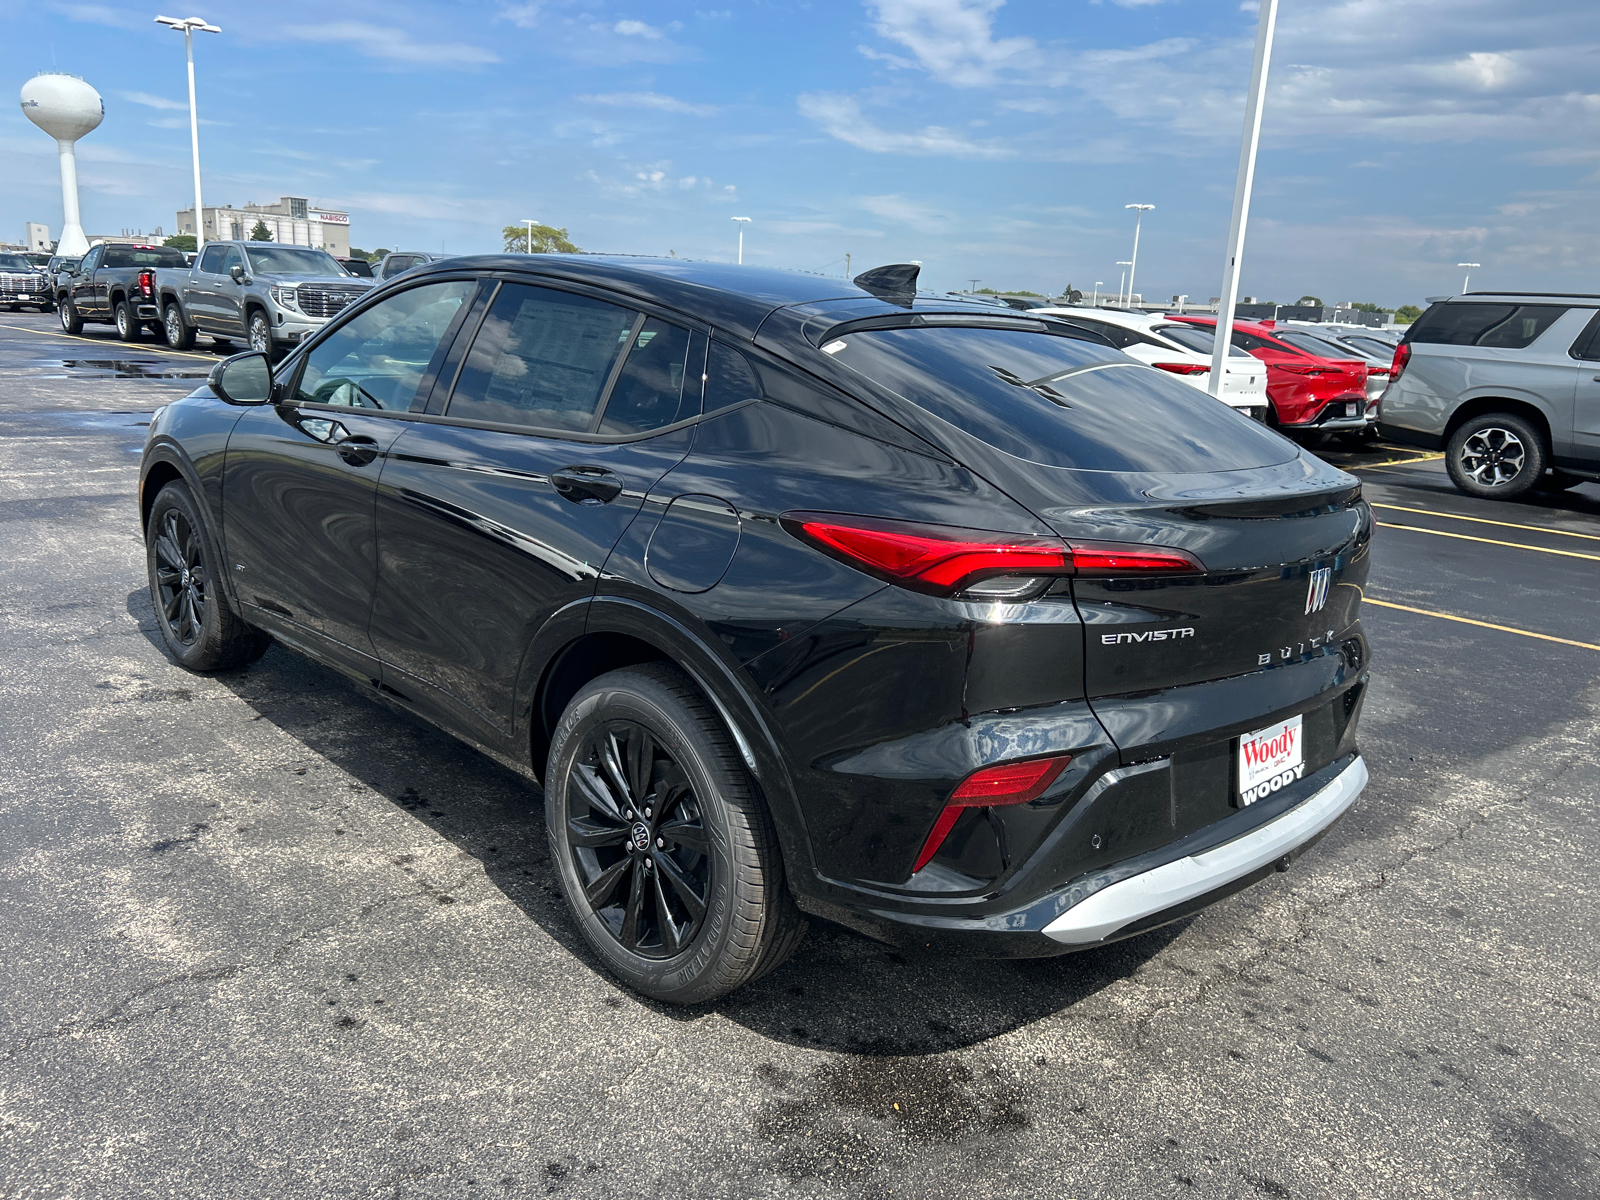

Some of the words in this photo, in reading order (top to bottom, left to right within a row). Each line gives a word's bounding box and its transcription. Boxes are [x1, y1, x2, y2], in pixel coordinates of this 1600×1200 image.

[320, 214, 348, 223] NABISCO
[1101, 627, 1195, 645] ENVISTA
[1257, 630, 1335, 666] BUICK
[1242, 725, 1297, 769] Woody
[1273, 756, 1286, 768] GMC
[1242, 762, 1305, 807] WOODY
